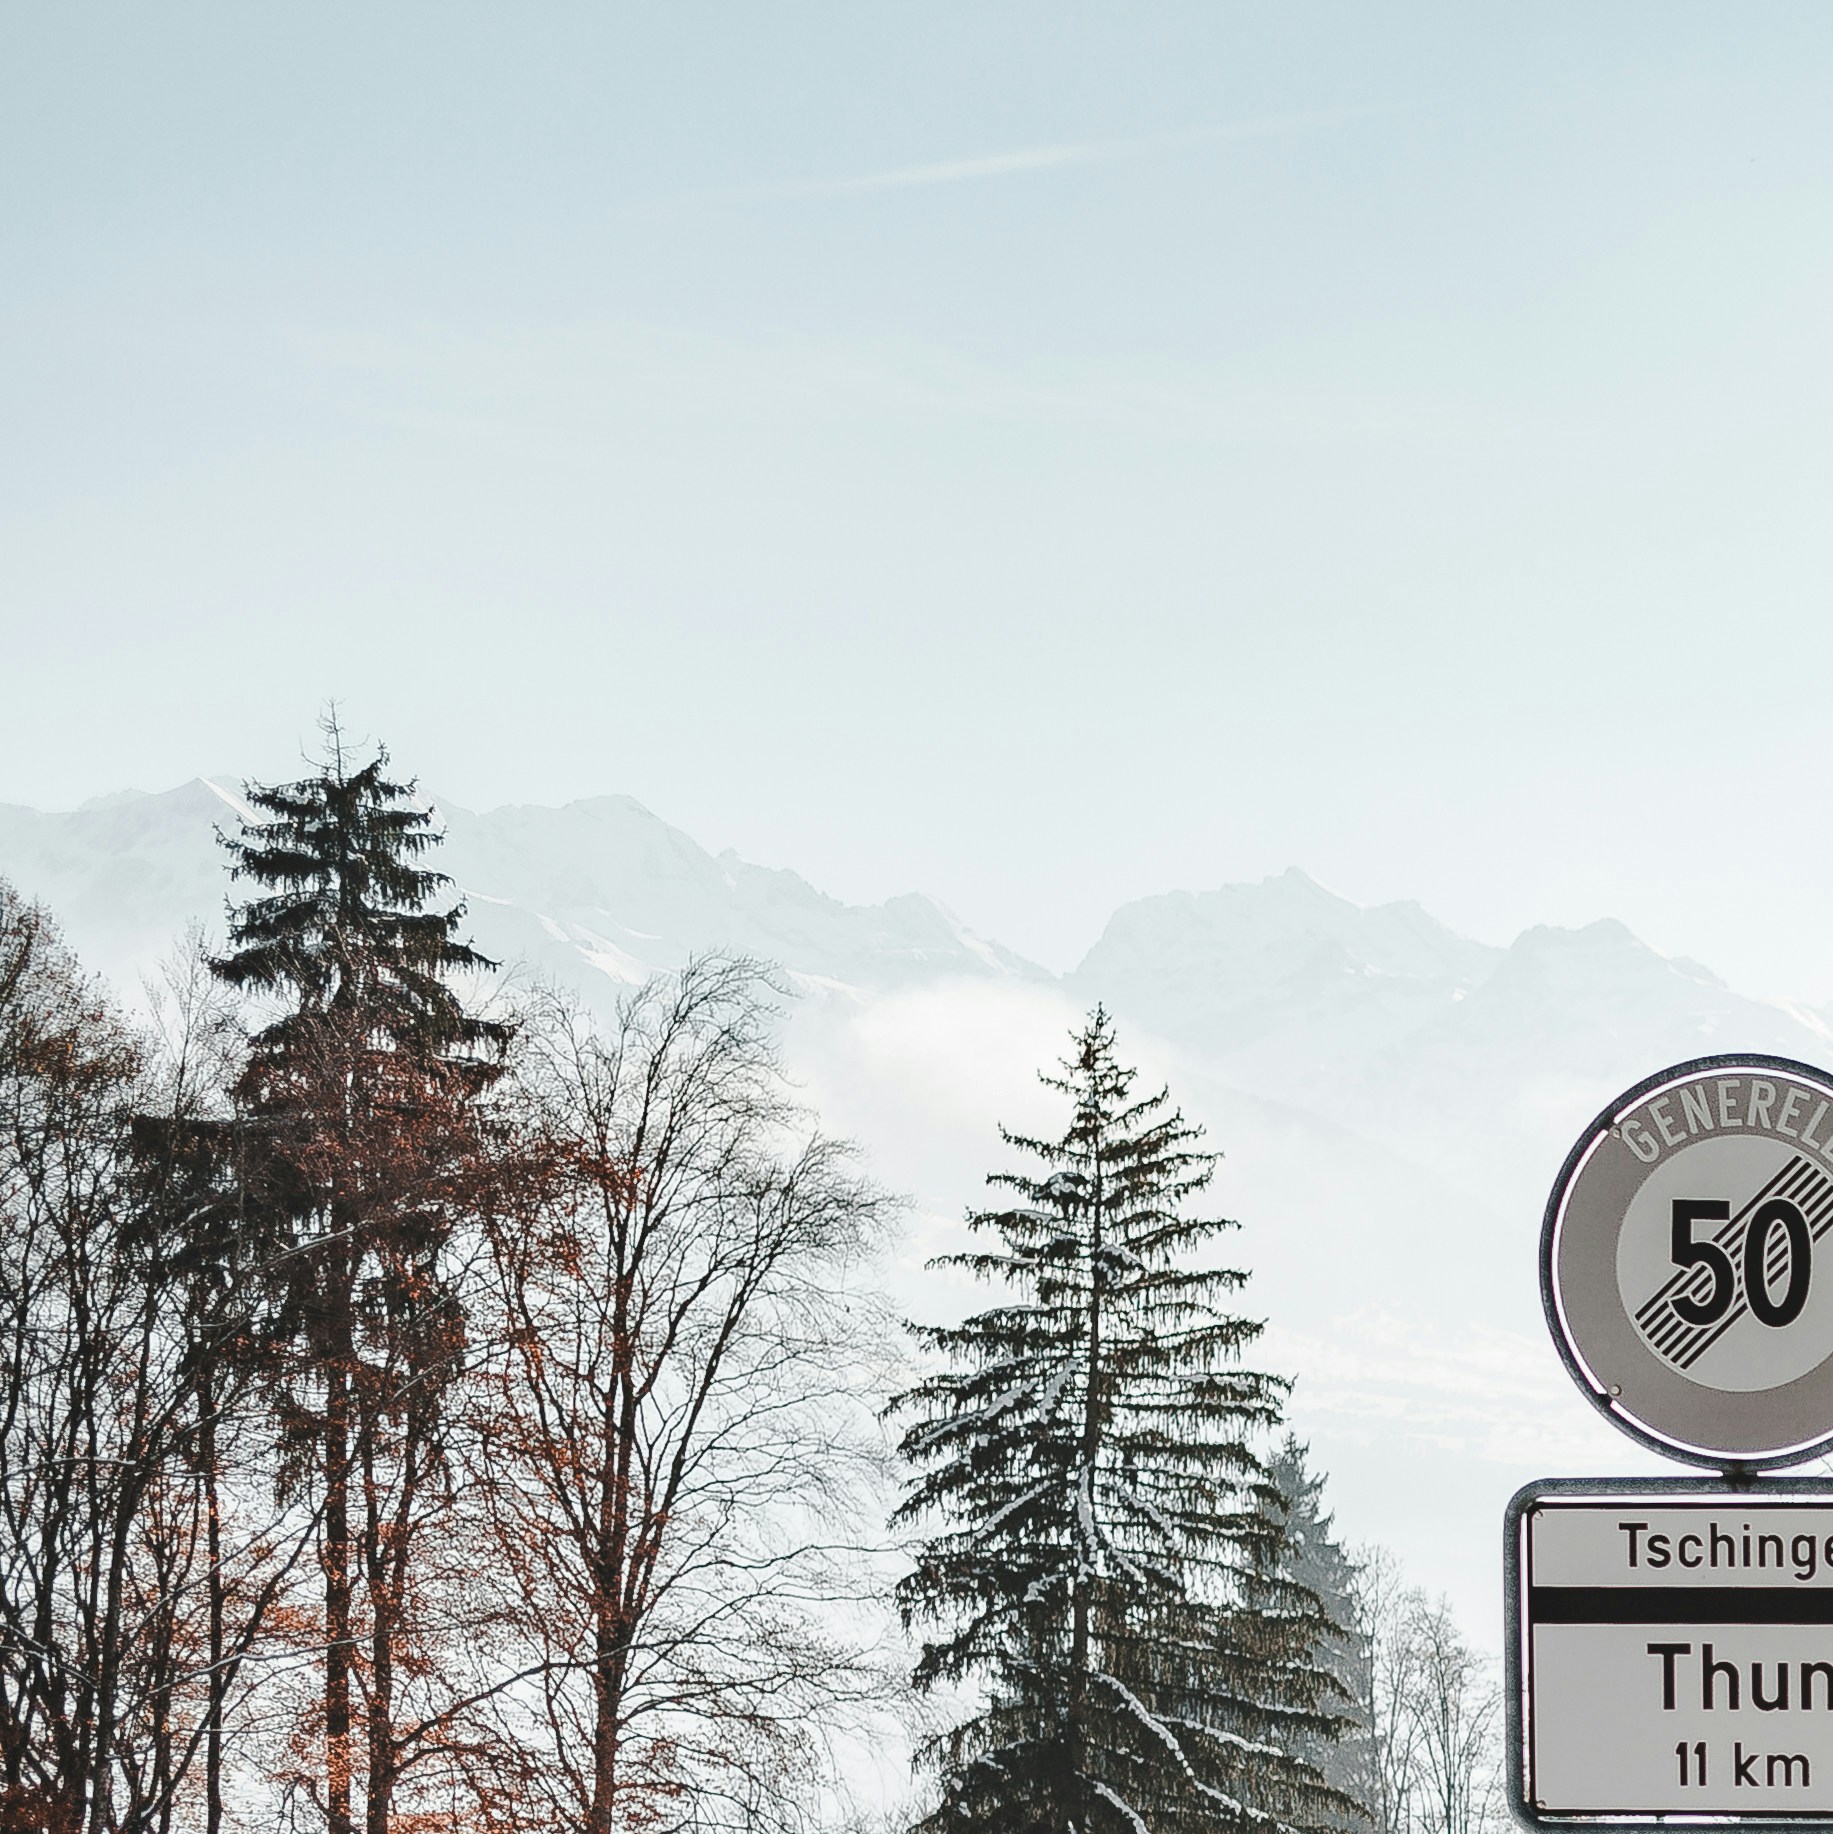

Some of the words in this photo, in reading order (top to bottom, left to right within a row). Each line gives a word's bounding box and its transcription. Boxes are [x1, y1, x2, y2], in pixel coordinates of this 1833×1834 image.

[1670, 1198, 1812, 1328] 50
[1675, 1741, 1707, 1787] 11
[1734, 1742, 1810, 1787] km
